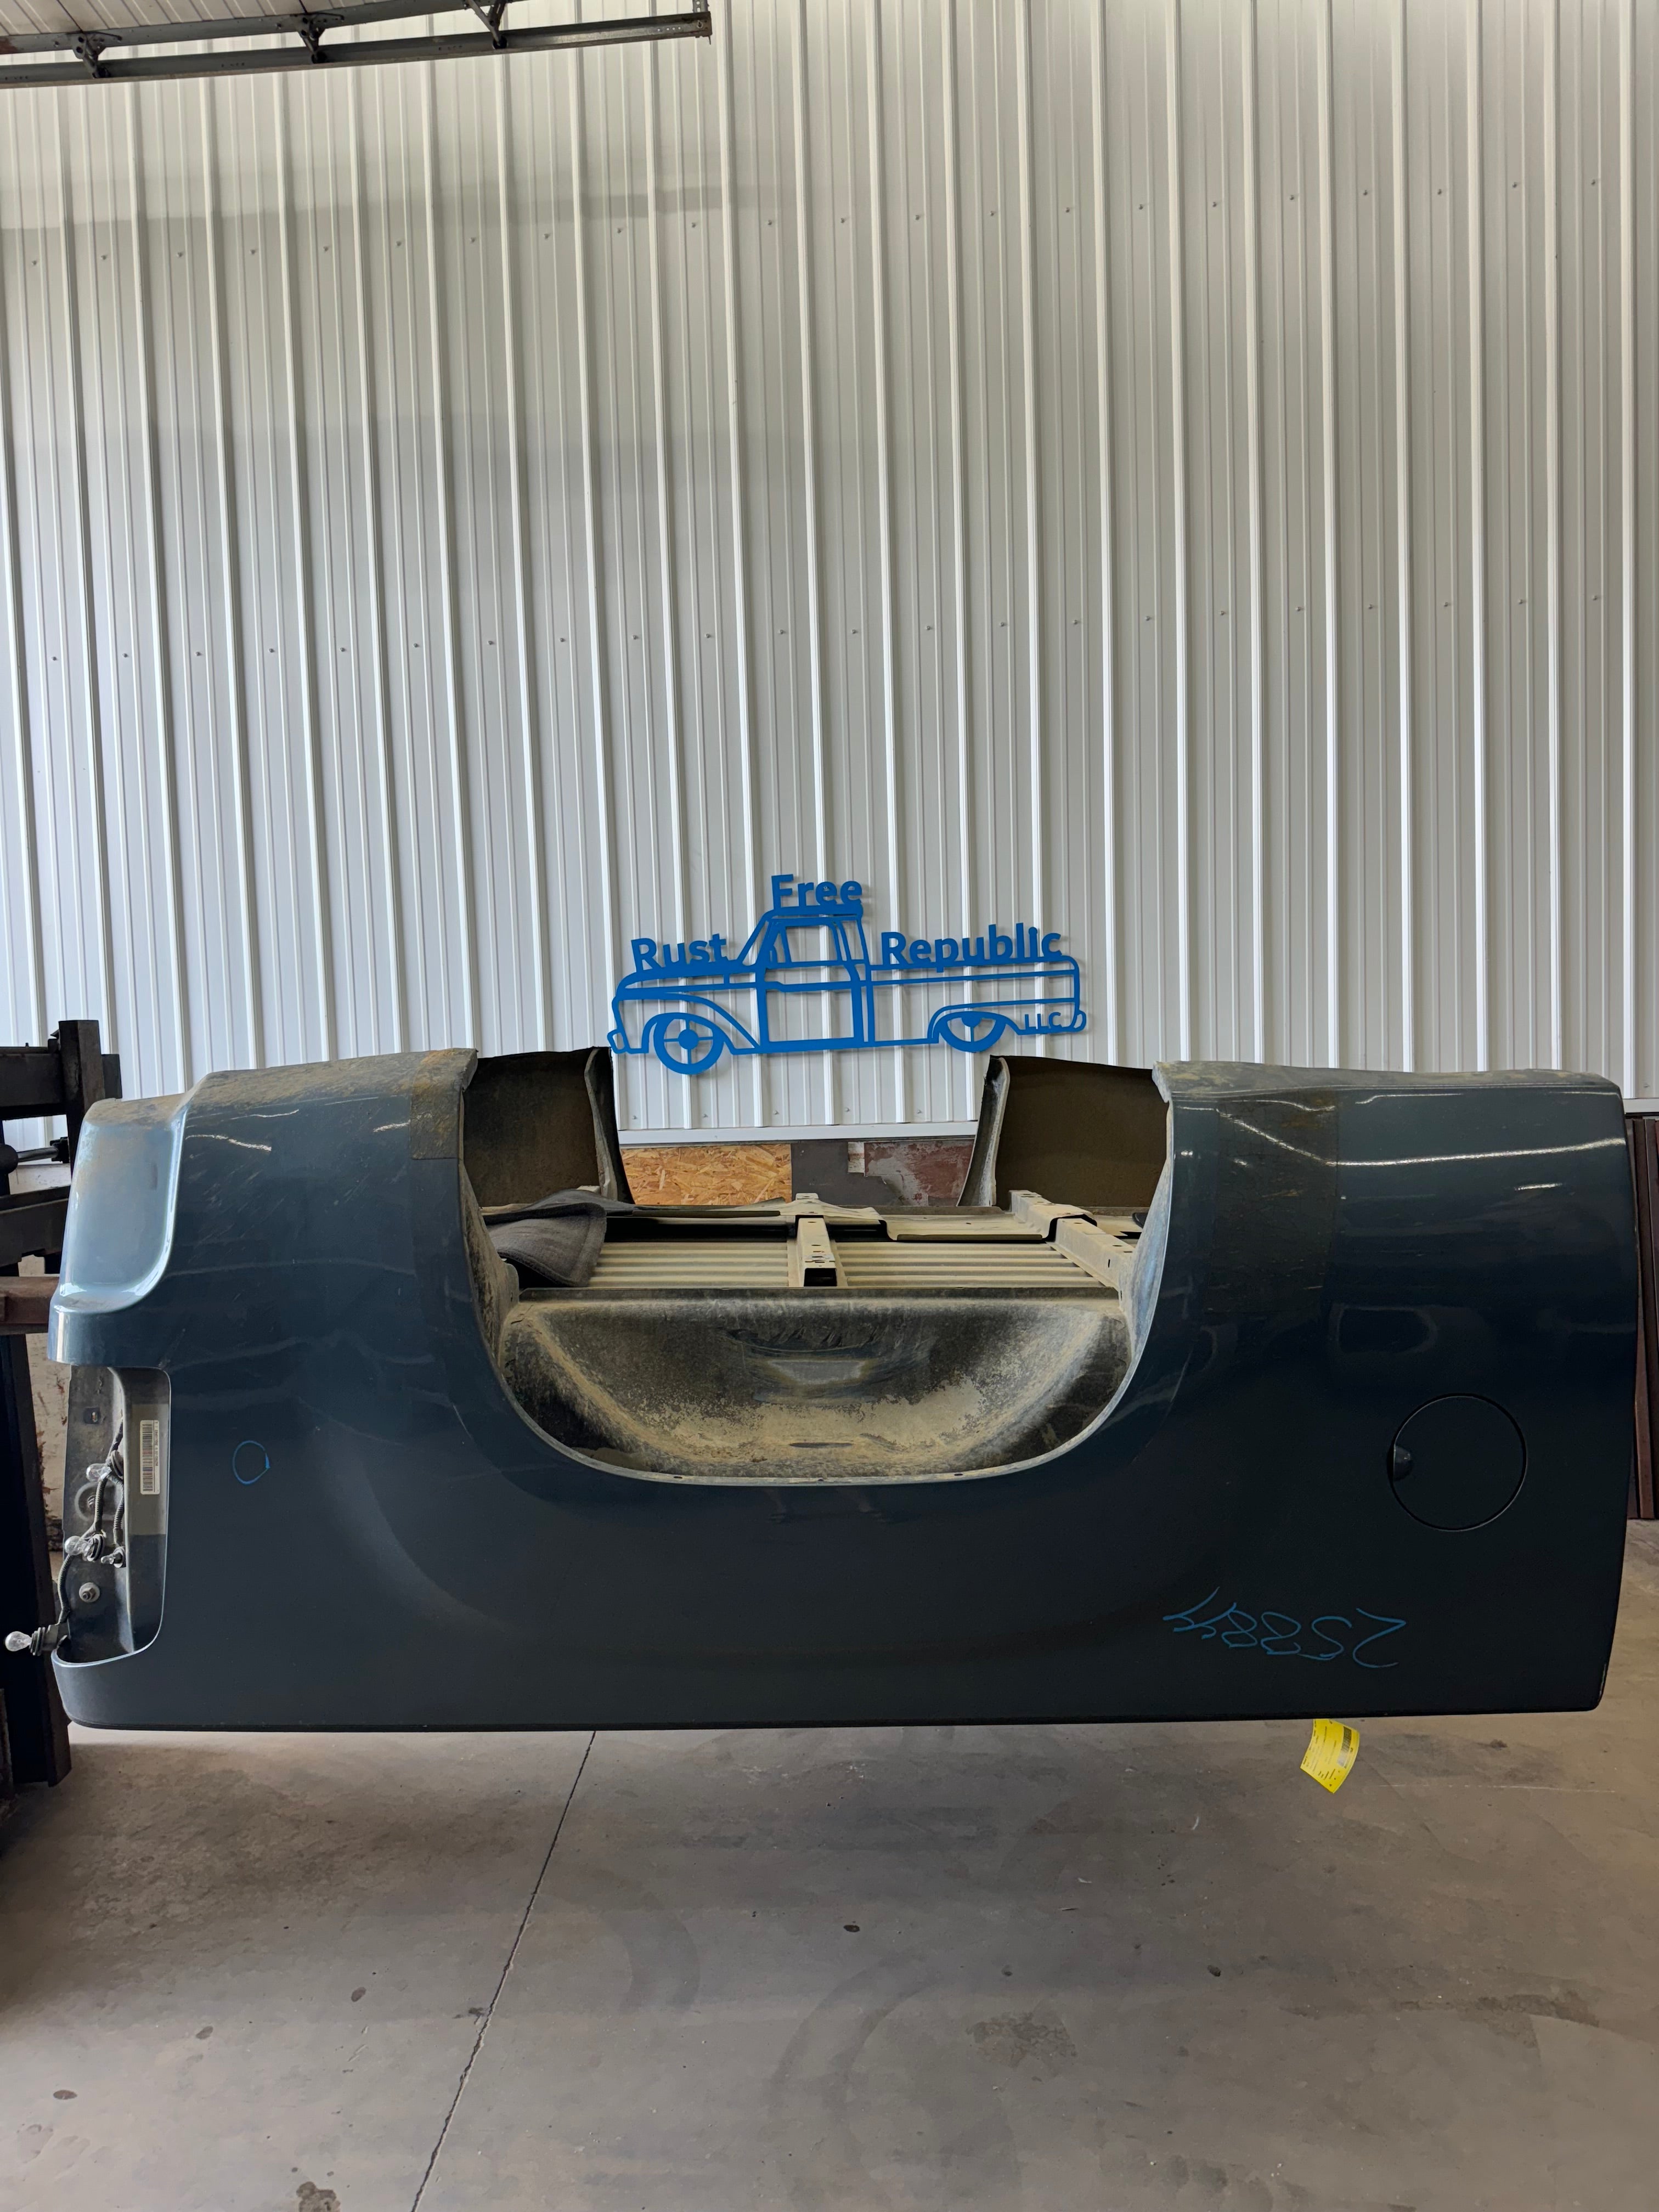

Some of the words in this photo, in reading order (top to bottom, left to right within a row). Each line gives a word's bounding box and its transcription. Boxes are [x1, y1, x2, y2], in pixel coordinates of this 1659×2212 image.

[771, 873, 863, 911] Free
[630, 933, 729, 973] Rust
[881, 922, 1062, 973] Republic
[1024, 1011, 1063, 1030] LLC
